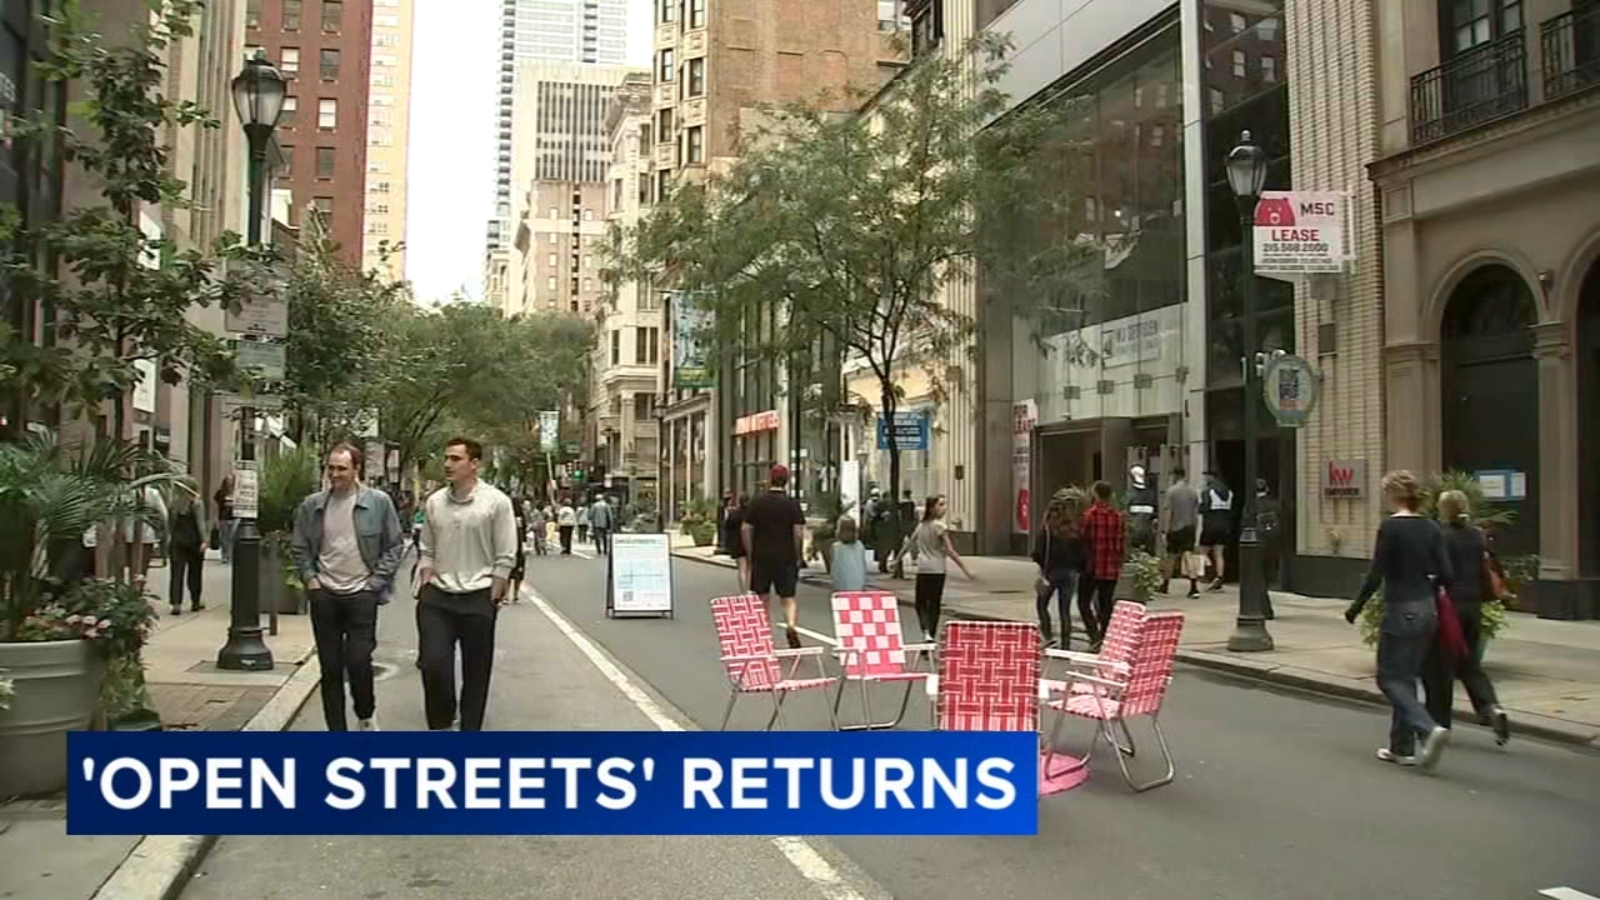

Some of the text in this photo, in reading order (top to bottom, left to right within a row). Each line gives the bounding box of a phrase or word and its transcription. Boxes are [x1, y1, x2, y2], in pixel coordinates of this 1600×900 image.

[1300, 202, 1335, 216] MSC
[1271, 229, 1319, 241] LEASE
[1328, 460, 1354, 482] kw
